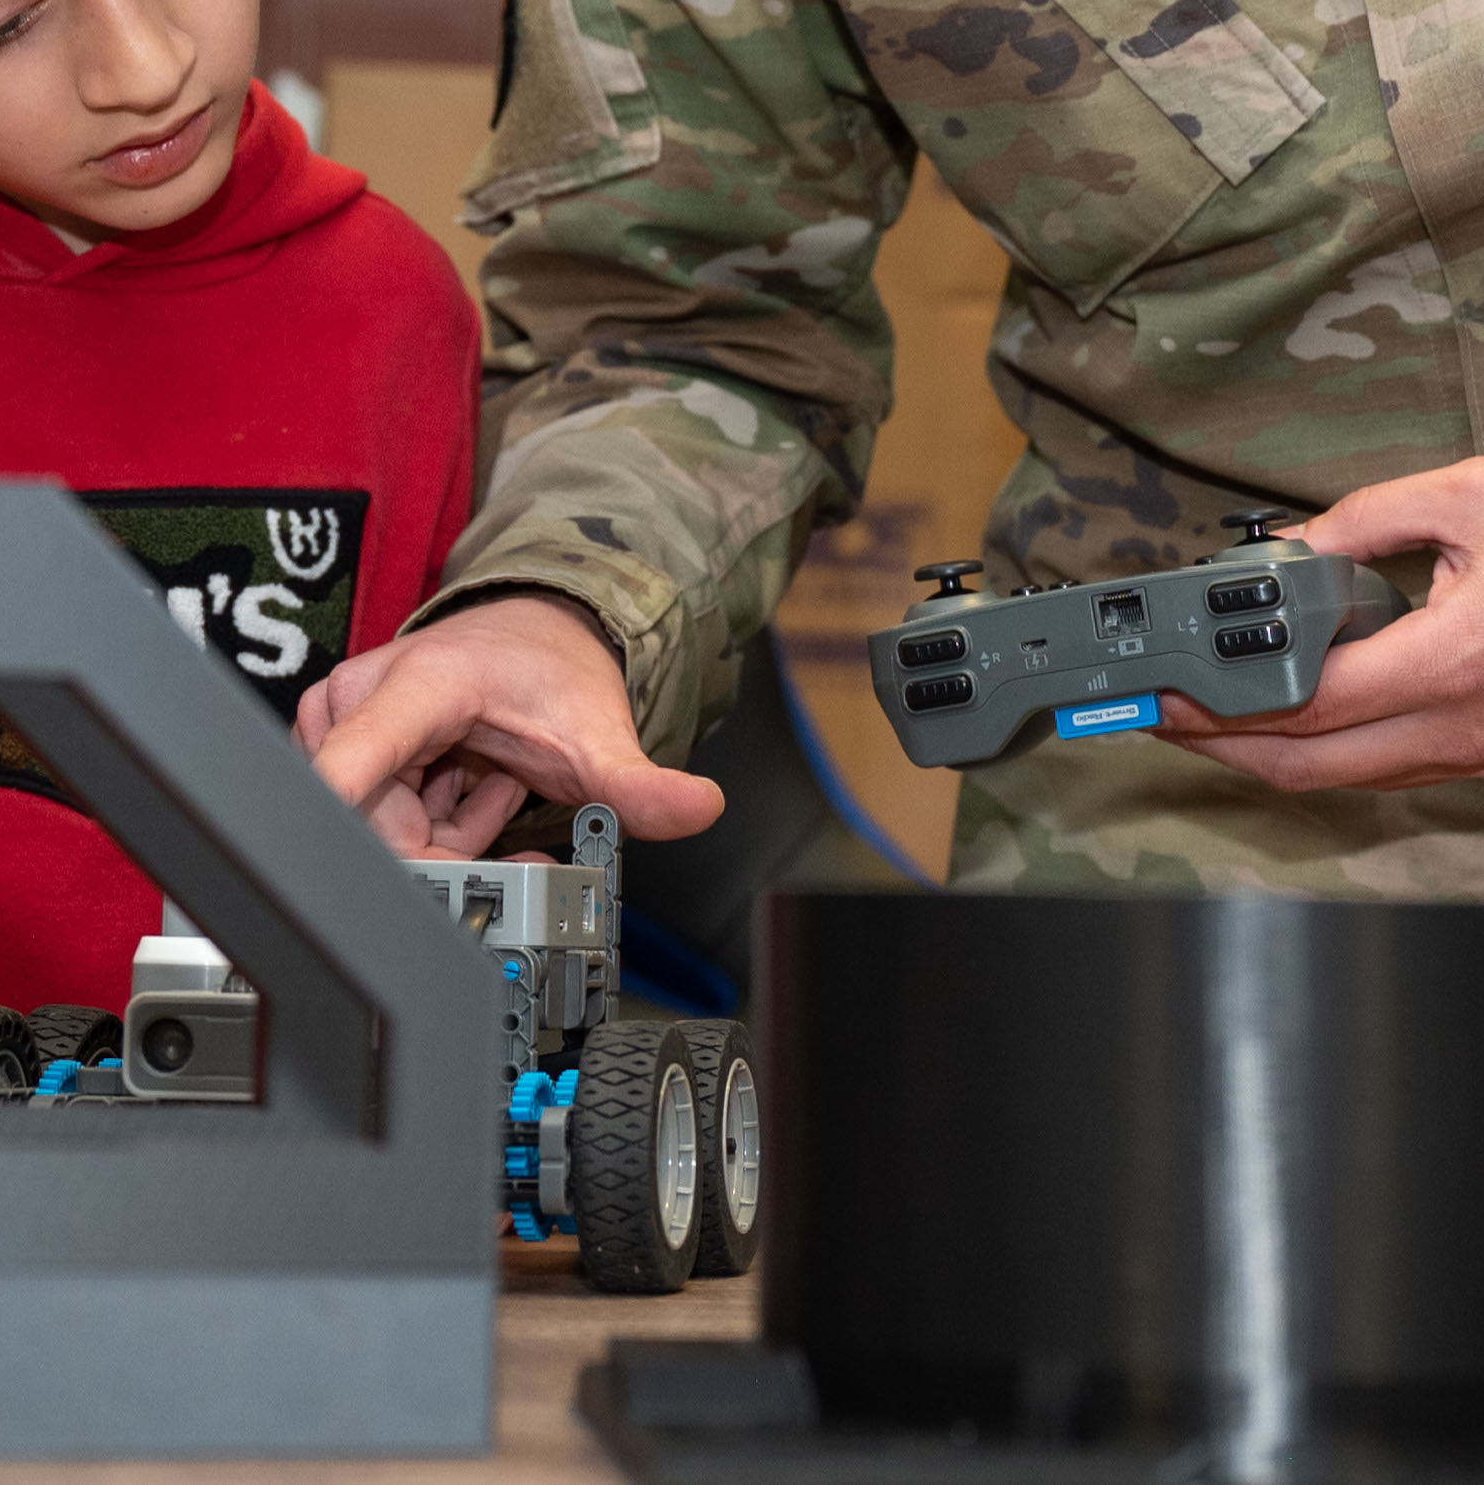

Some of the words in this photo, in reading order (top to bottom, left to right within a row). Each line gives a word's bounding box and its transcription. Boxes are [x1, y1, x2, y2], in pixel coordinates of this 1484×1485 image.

[991, 651, 1002, 665] R
[1075, 713, 1104, 723] Radio
[1105, 707, 1137, 718] Smart
